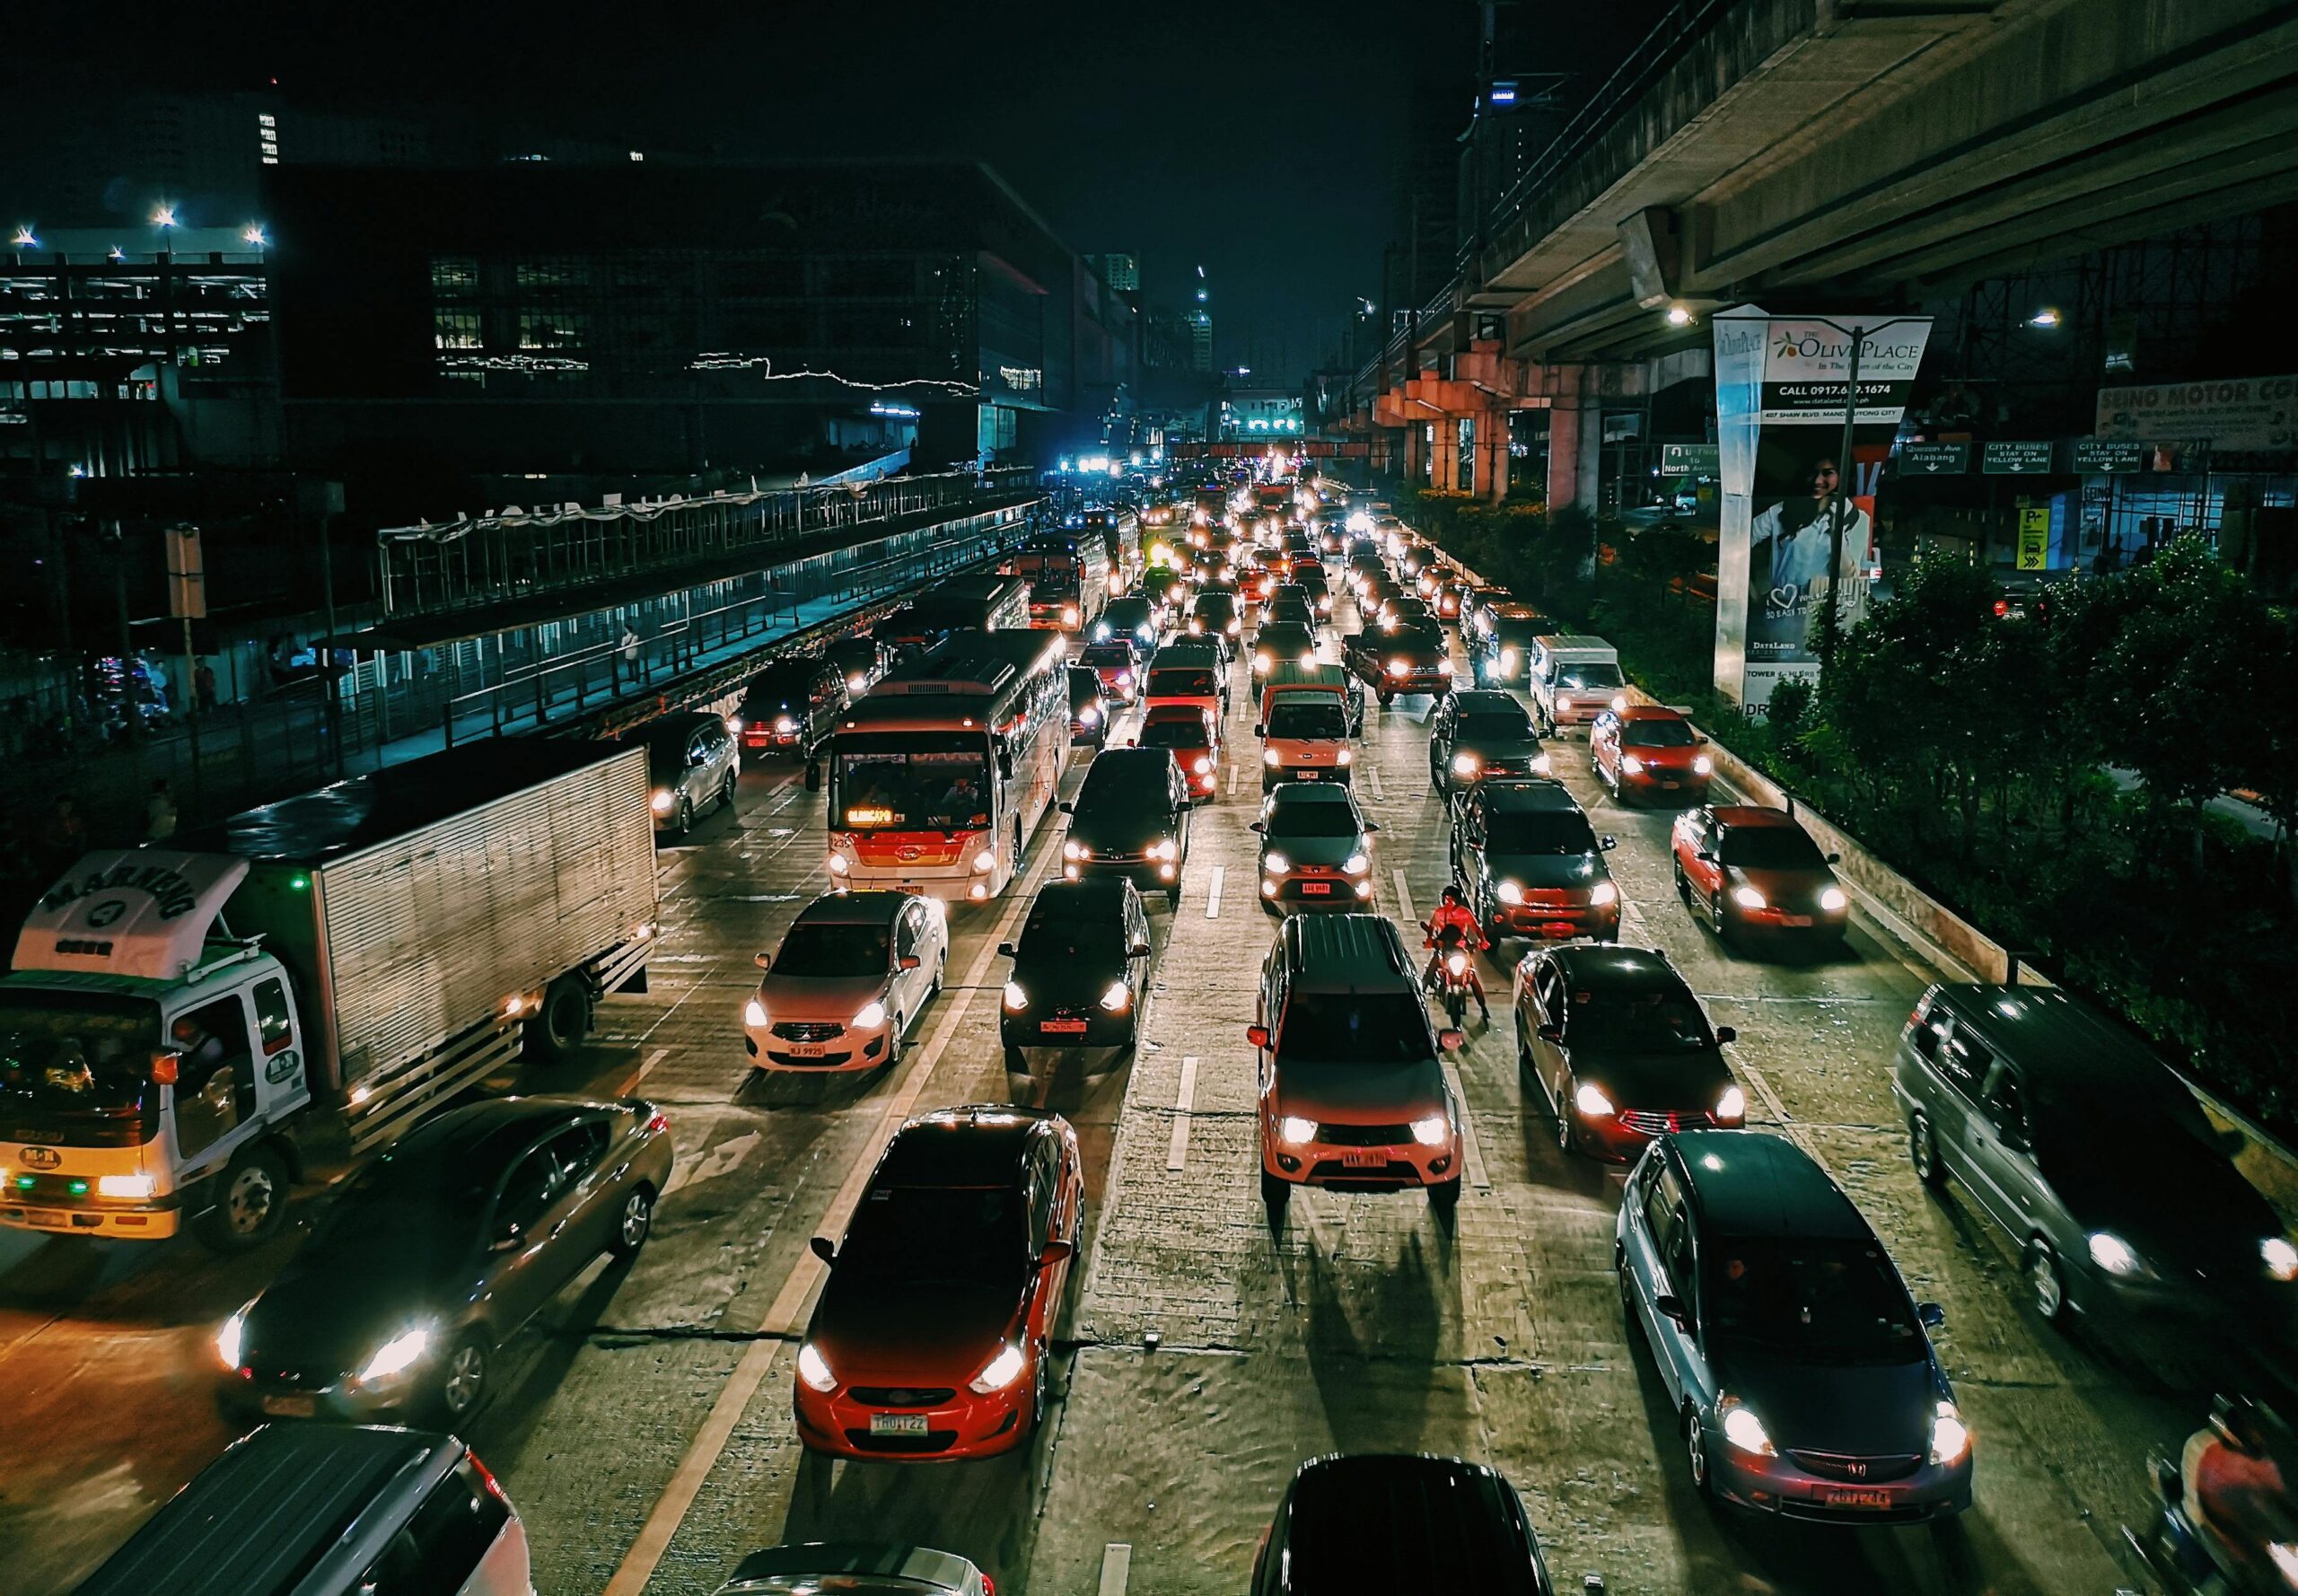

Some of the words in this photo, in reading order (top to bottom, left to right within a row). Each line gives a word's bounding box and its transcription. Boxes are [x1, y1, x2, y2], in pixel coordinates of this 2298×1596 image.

[1799, 338, 1853, 358] OLIV
[1860, 340, 1919, 358] PLACE
[1830, 362, 1845, 370] The
[1882, 361, 1895, 370] the
[1897, 360, 1915, 371] City
[1779, 387, 1808, 396] CALL
[1810, 385, 1890, 396] 0917.69.1674
[2167, 383, 2250, 406] MOTOR
[2259, 380, 2298, 401] CO
[1823, 410, 1879, 418] MANDUYONG
[1944, 444, 1960, 452] Ave
[1912, 453, 1955, 462] Alabang
[1664, 464, 1689, 472] North
[1767, 610, 1776, 619] SO
[1776, 608, 1795, 618] EASY
[1796, 607, 1807, 615] TO
[1746, 704, 1767, 716] DR
